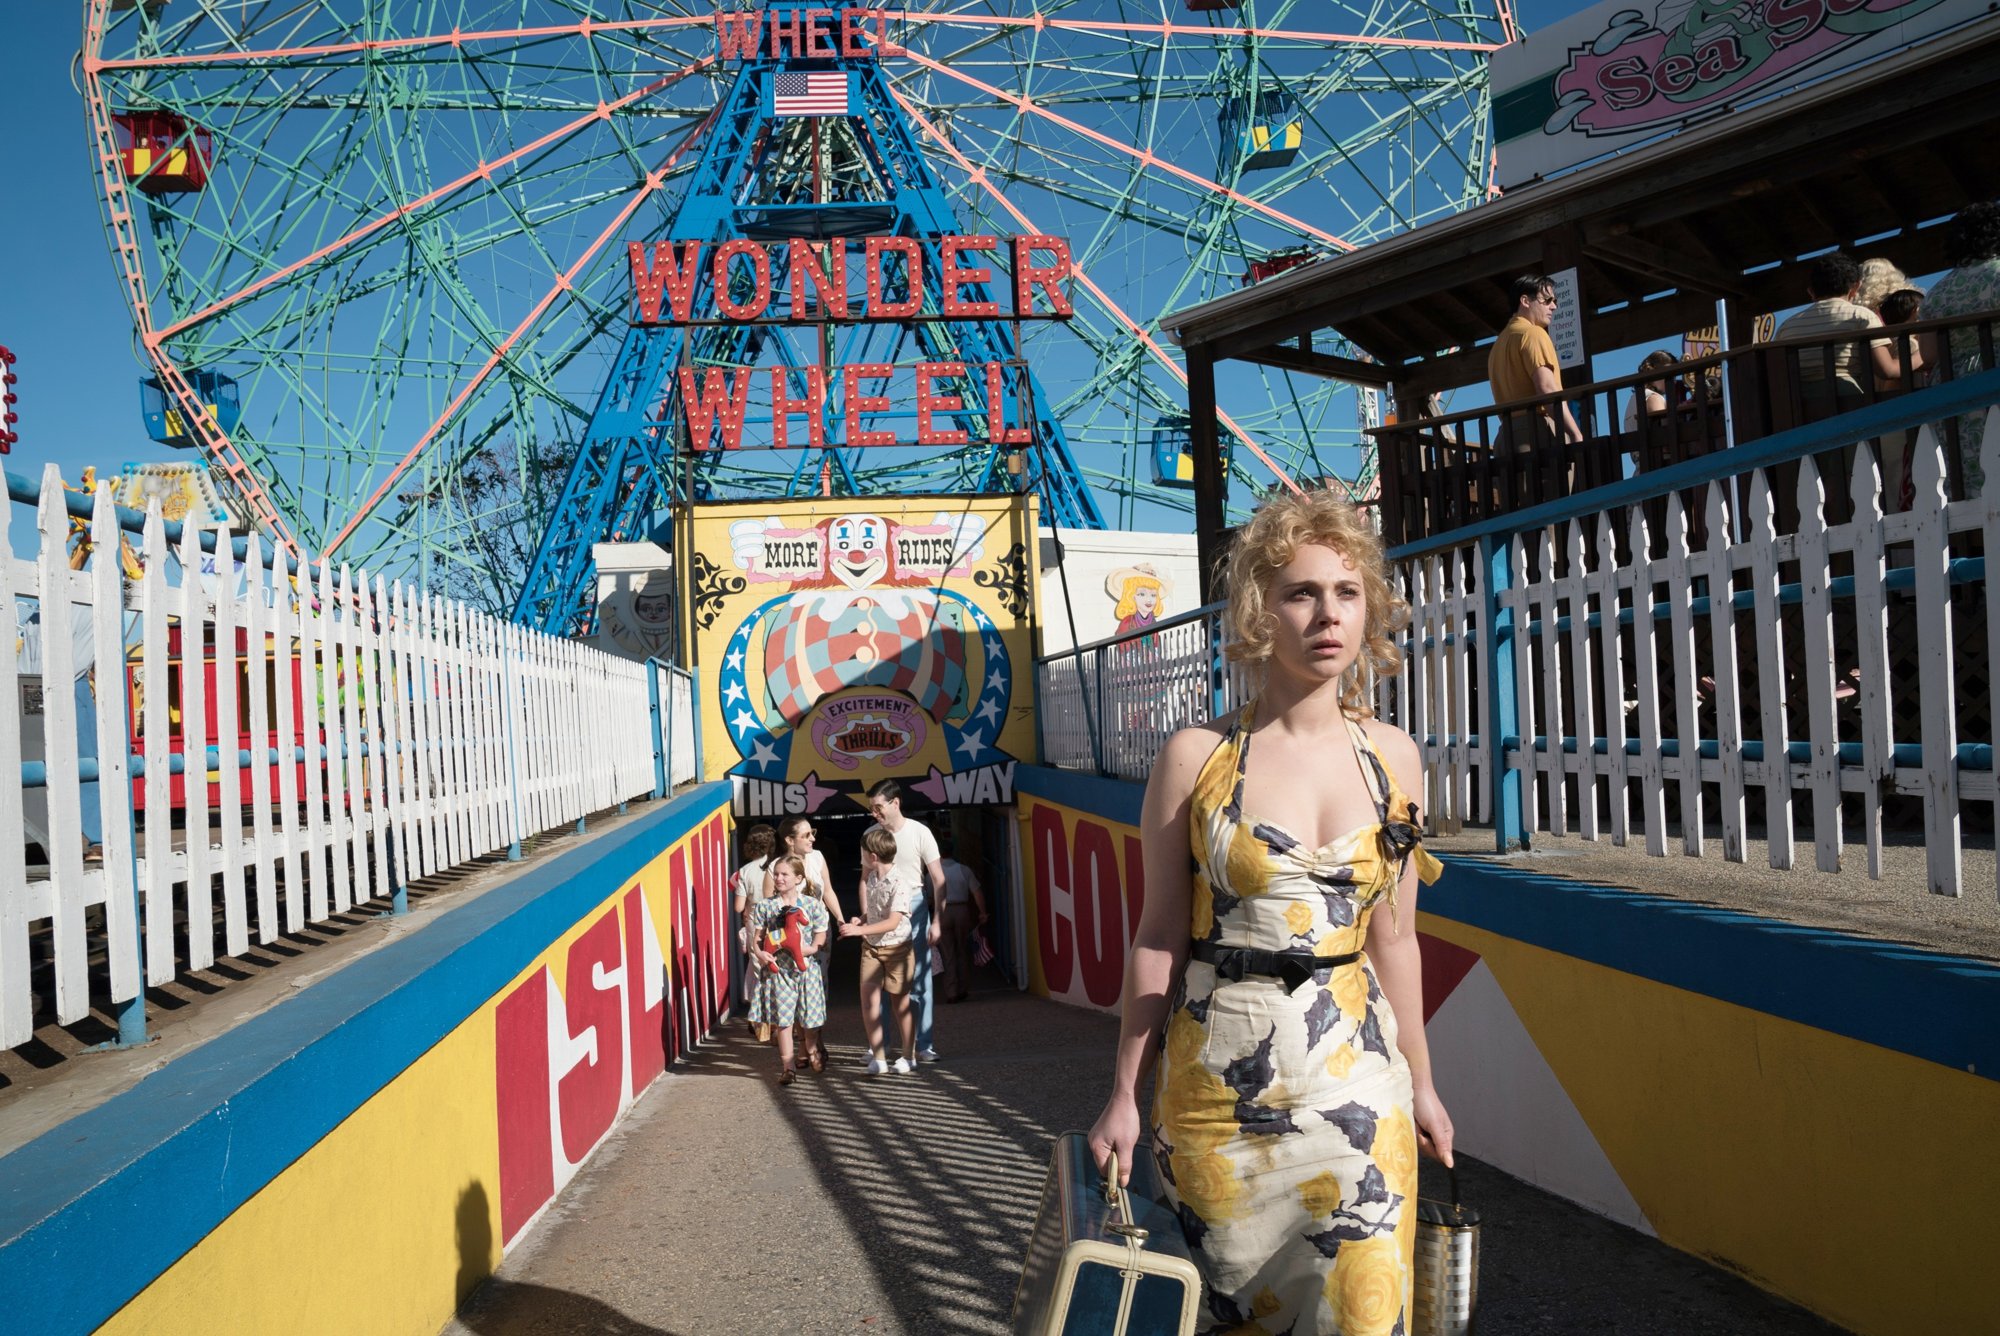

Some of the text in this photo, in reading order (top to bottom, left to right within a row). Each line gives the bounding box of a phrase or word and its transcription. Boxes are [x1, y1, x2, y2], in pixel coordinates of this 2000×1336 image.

[715, 8, 907, 59] WHEEL
[1597, 36, 1746, 110] Sea
[629, 235, 1073, 322] WONDER
[1554, 289, 1570, 299] orget
[1554, 309, 1574, 321] and say
[1555, 330, 1575, 341] for the
[679, 362, 1032, 451] WHEEL
[765, 538, 953, 569] MORE RIDES
[828, 699, 911, 717] EXCITEMENT
[842, 730, 899, 751] THRILLS
[729, 760, 1018, 817] THIS WAY
[495, 812, 730, 1250] ISLAND
